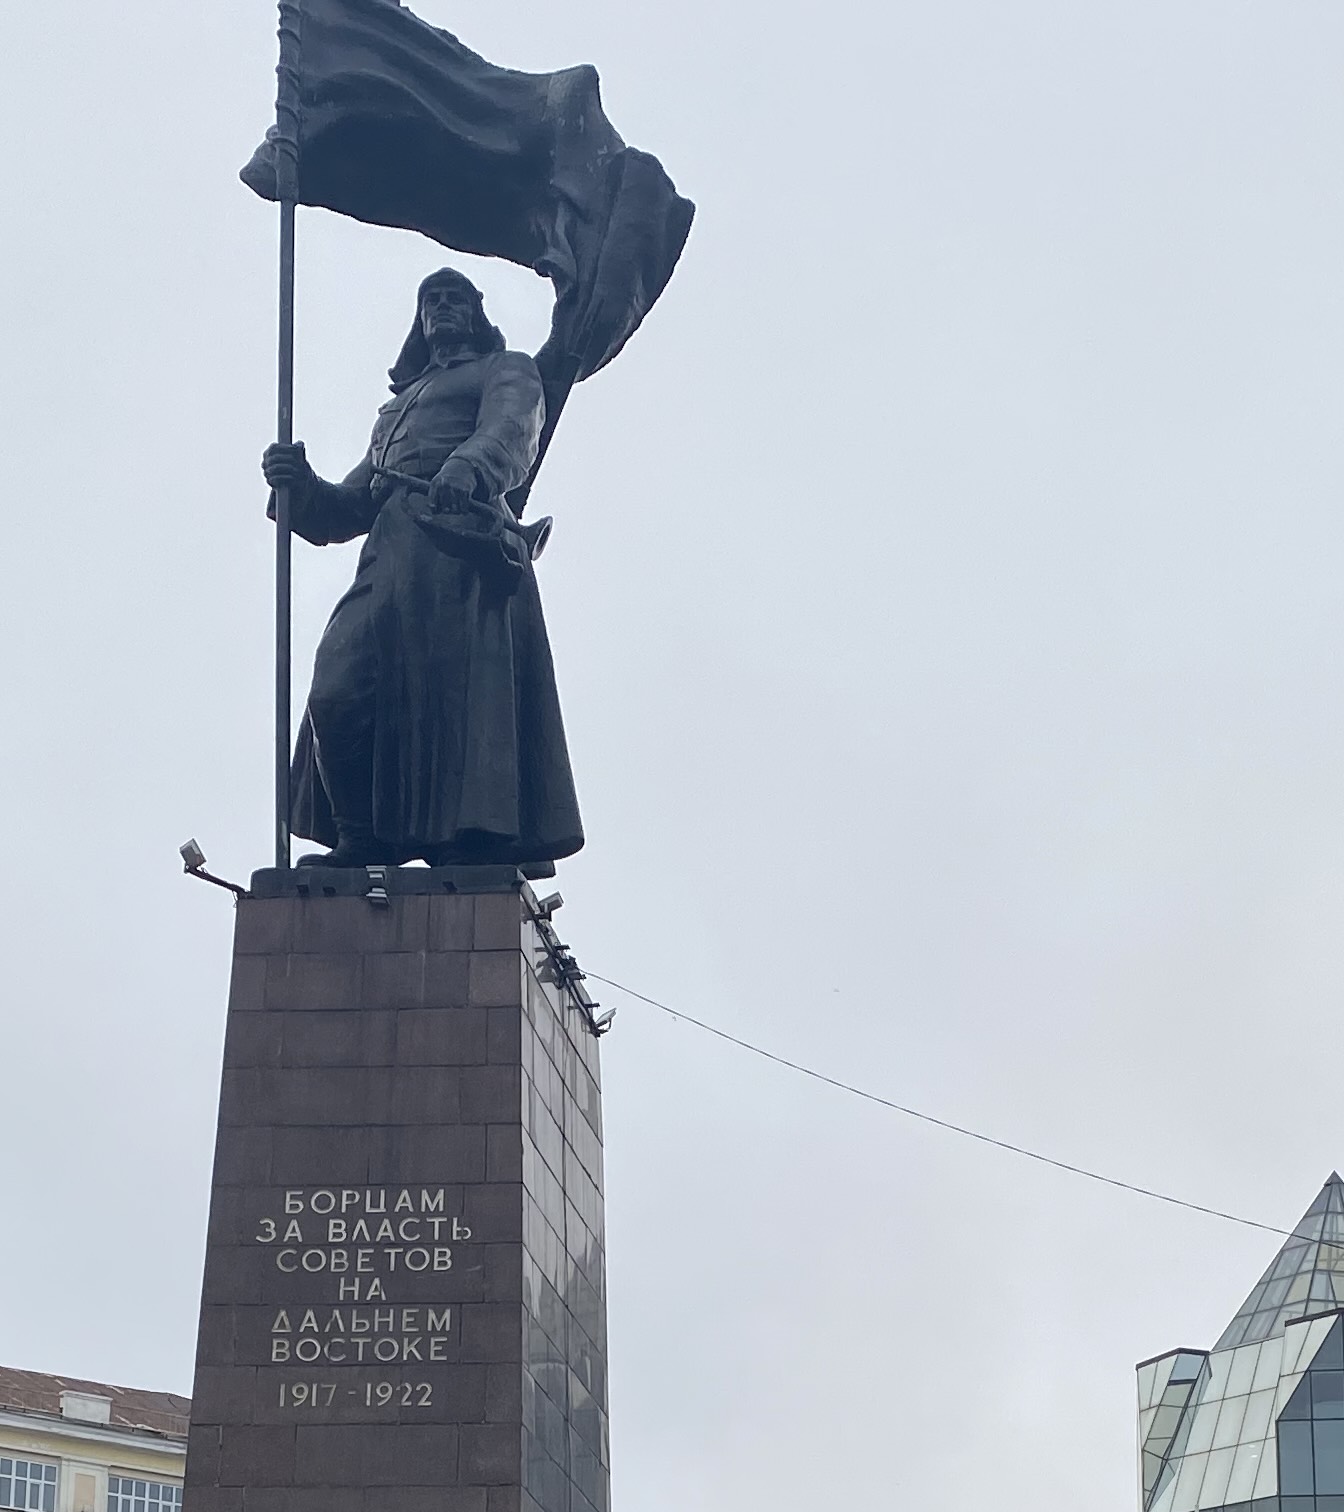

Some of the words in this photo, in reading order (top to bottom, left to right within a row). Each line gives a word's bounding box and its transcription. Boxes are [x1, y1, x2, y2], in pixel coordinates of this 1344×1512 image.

[284, 1189, 445, 1214] БОРЦАМ
[256, 1217, 303, 1243] ЗА
[328, 1216, 472, 1242] ВЛАСТЬ
[276, 1247, 453, 1273] СОВЕТОВ
[339, 1277, 387, 1301] НА
[271, 1308, 451, 1333] ДАЛЬНЕМ
[271, 1337, 448, 1362] ВОСТОКЕ
[279, 1382, 337, 1407] 1917
[366, 1381, 433, 1407] 1922
